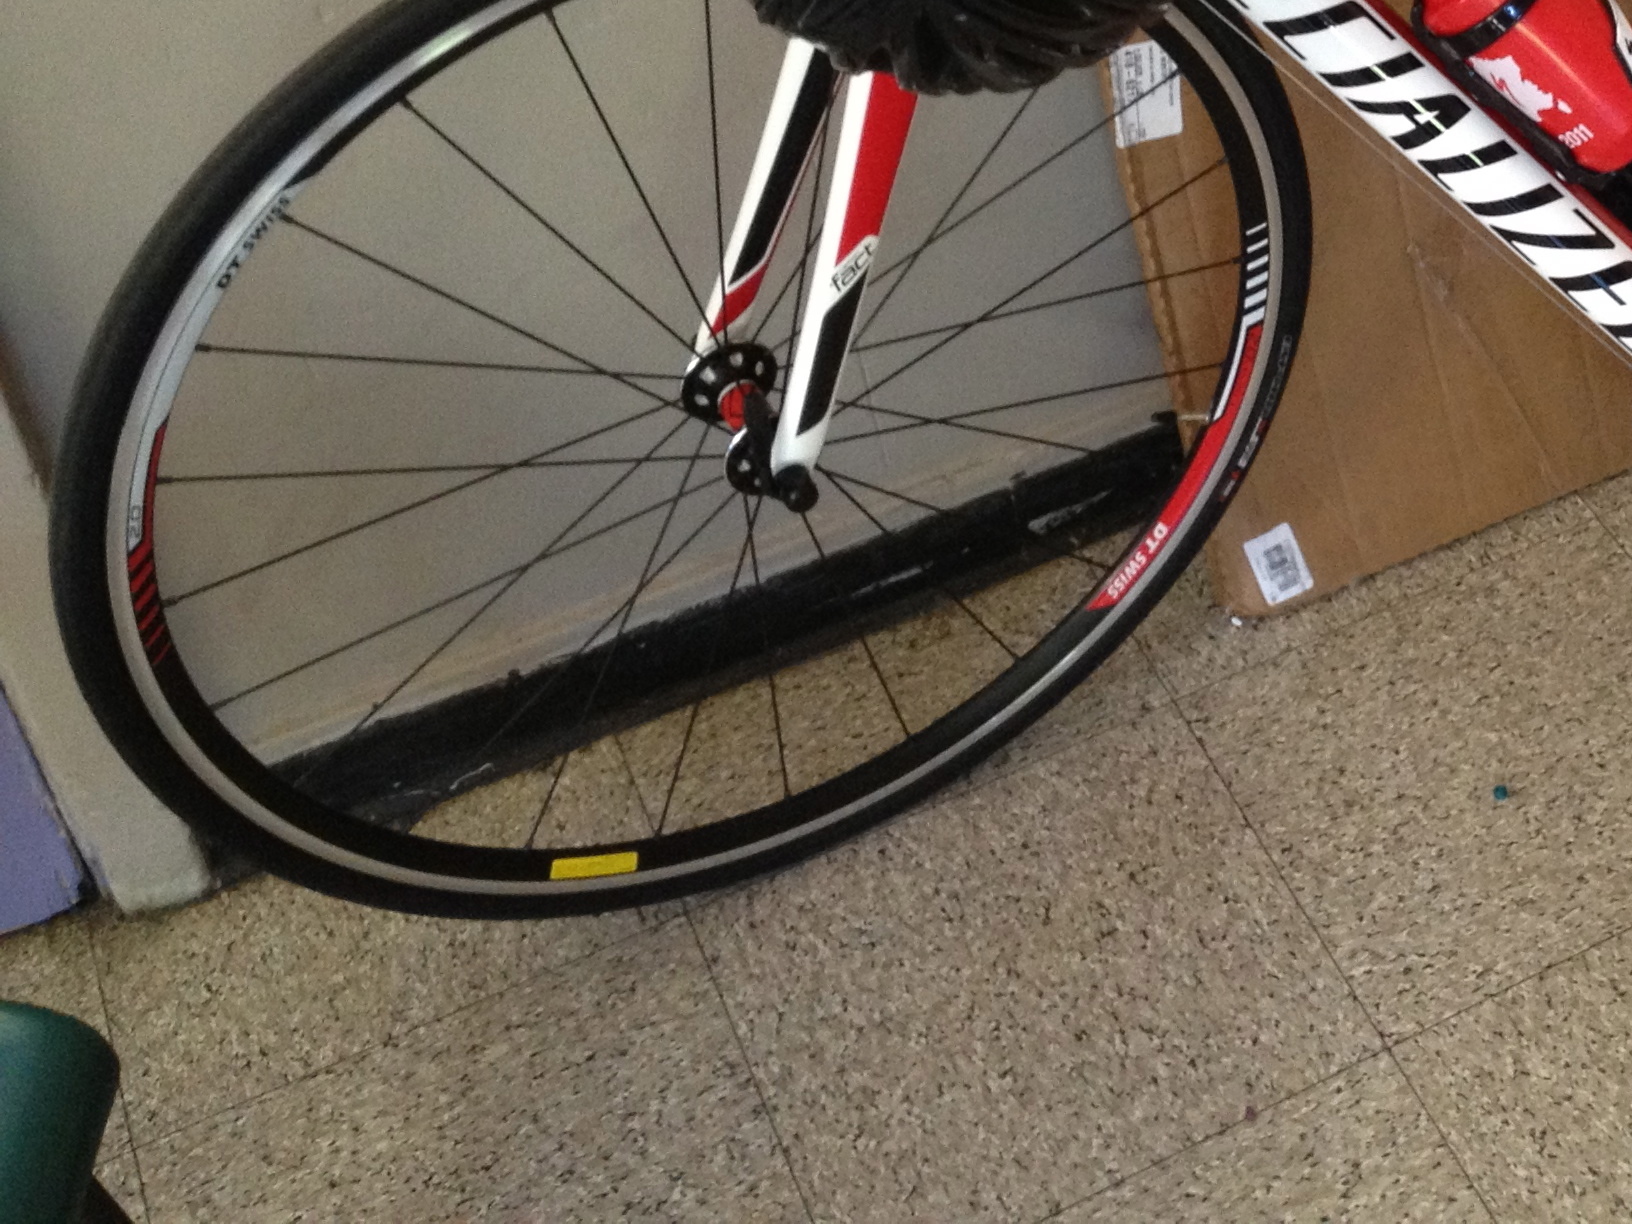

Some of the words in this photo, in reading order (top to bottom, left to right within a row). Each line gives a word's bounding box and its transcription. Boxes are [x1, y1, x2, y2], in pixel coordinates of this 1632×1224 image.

[1557, 122, 1595, 150] 2011
[1144, 520, 1169, 555] DT
[1107, 550, 1148, 600] SWISS
